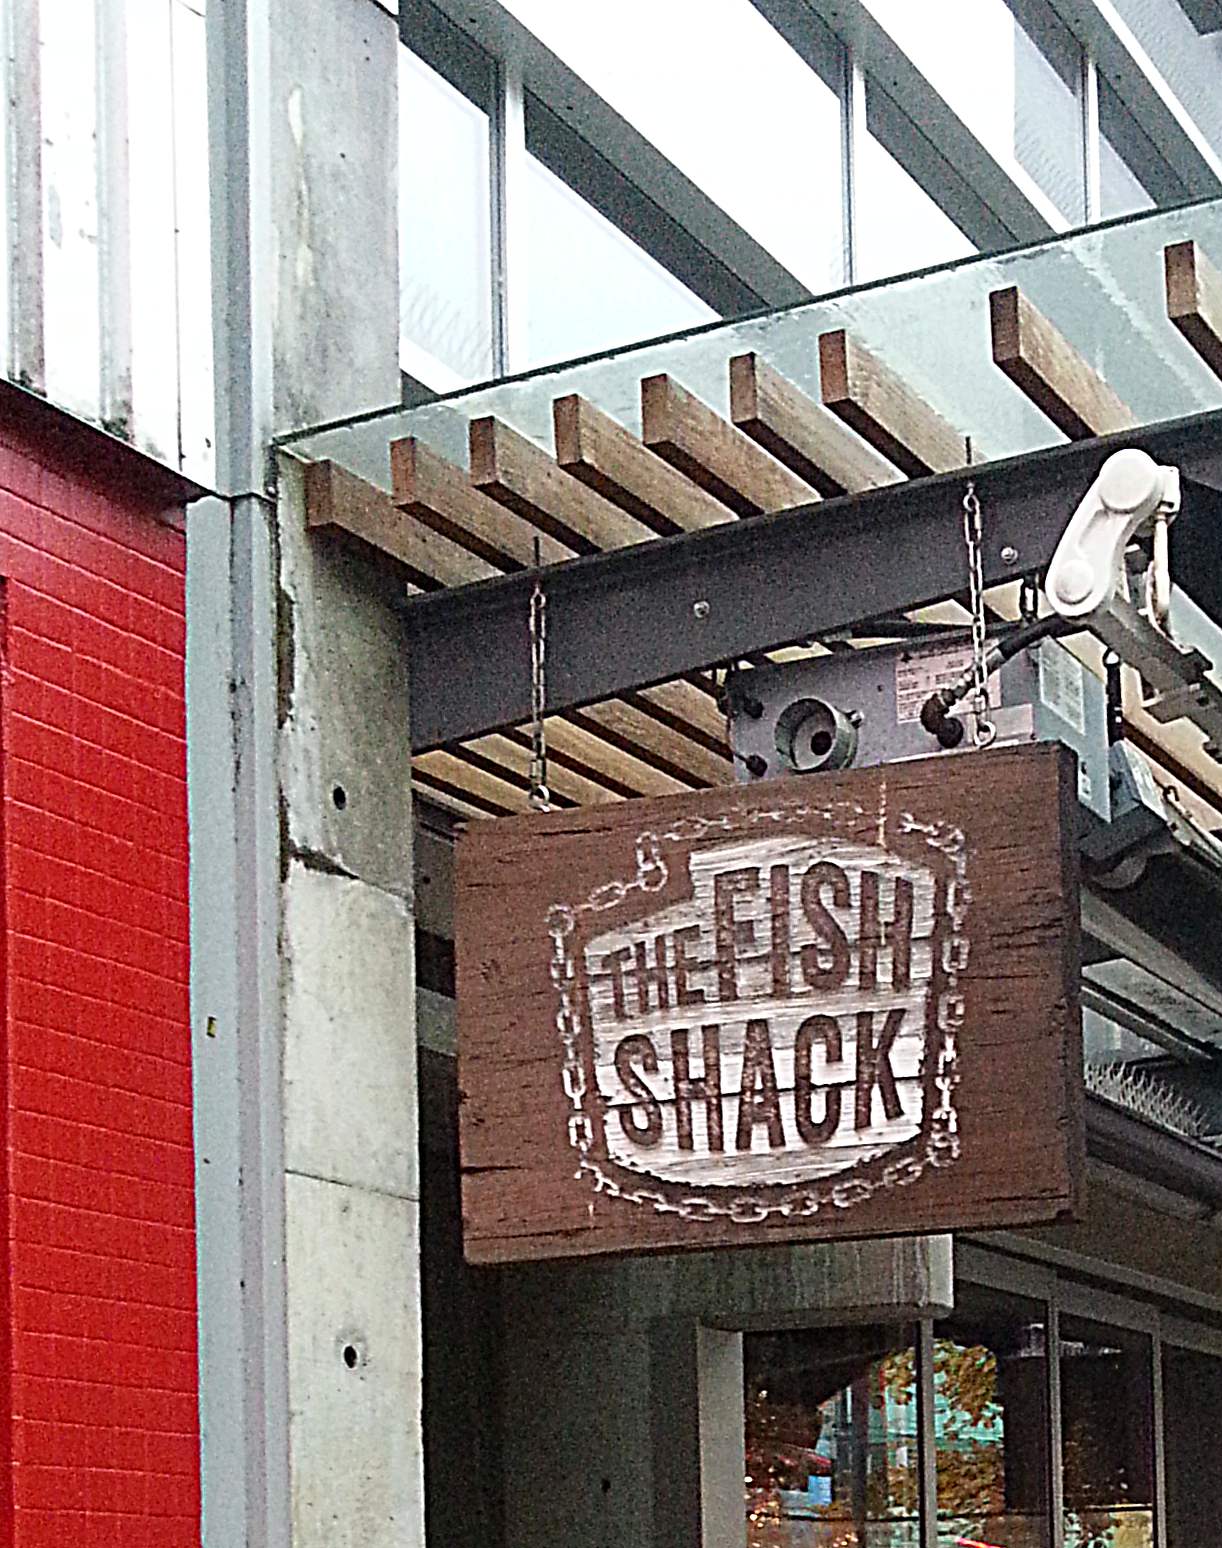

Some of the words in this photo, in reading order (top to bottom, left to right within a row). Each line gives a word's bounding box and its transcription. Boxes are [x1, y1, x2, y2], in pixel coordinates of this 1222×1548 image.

[602, 925, 705, 1019] THE
[714, 861, 913, 1001] FISH
[614, 1008, 907, 1151] SHACK
